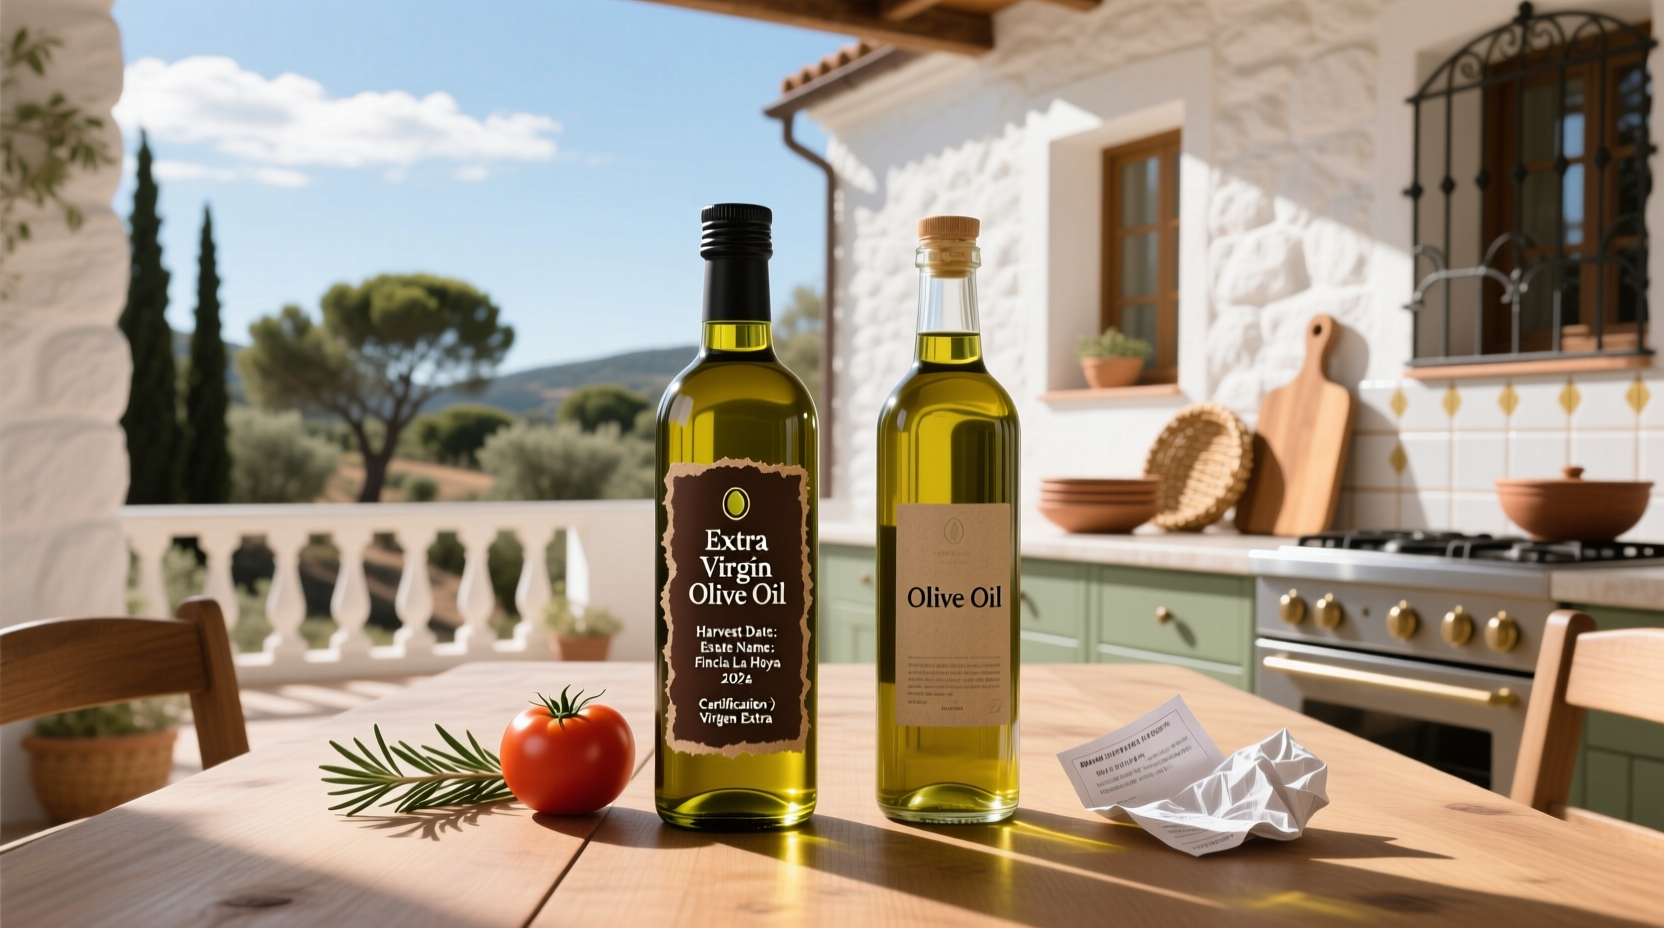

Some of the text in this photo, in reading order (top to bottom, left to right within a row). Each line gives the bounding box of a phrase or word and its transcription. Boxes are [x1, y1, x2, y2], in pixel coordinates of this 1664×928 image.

[704, 528, 769, 551] Extra
[688, 581, 787, 606] Olive Oil
[907, 585, 1002, 609] Olive Oil
[696, 625, 742, 638] Harvest
[733, 656, 747, 668] La
[750, 656, 781, 672] Hoya
[741, 712, 773, 724] Extra
